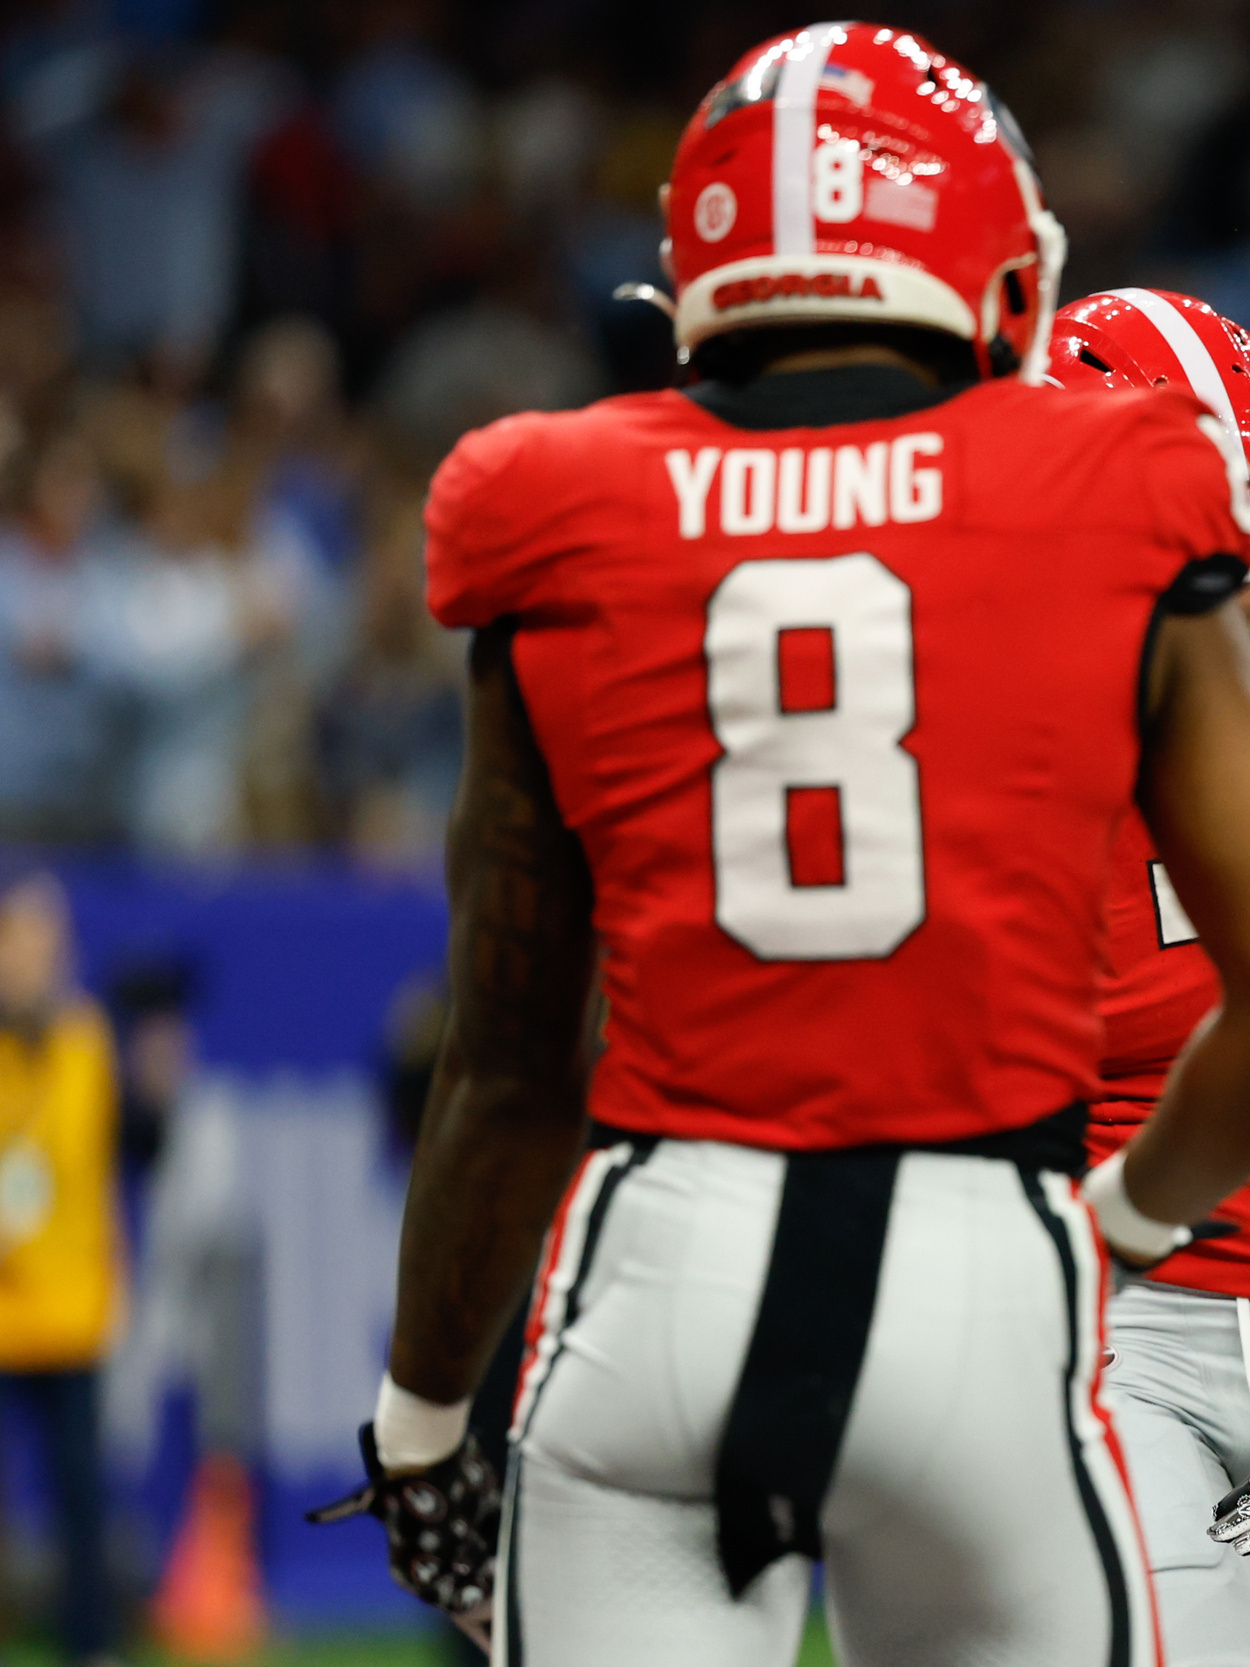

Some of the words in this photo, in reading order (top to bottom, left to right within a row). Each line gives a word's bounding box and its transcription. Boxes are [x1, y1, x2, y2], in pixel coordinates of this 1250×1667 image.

[814, 144, 863, 224] 8
[665, 432, 943, 540] YOUNG
[703, 551, 926, 962] 8
